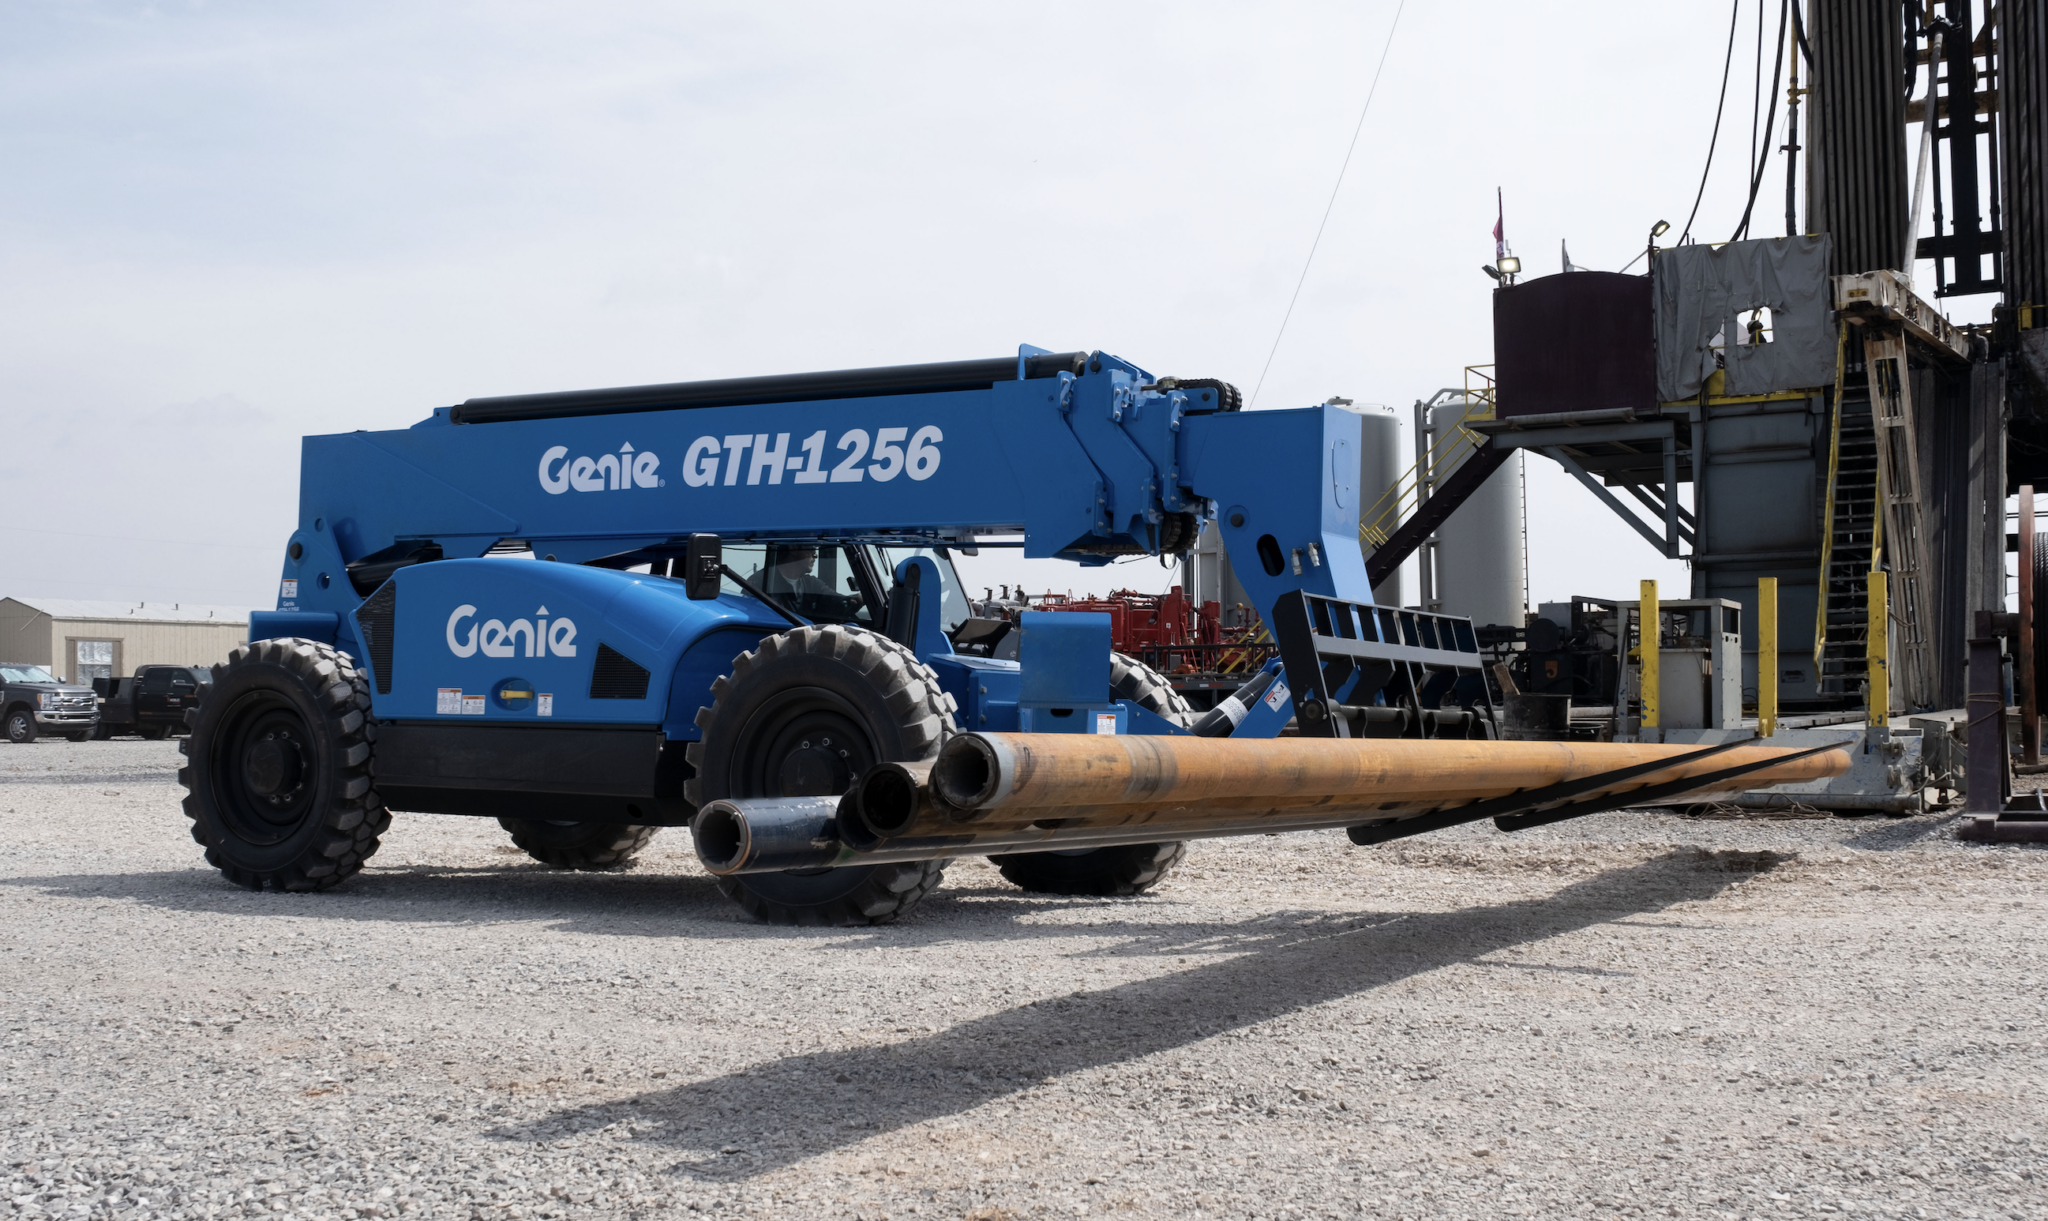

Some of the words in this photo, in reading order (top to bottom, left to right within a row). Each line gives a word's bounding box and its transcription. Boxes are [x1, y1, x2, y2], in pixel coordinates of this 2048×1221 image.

[538, 441, 660, 495] Genie
[682, 425, 943, 487] GTH-1256
[446, 604, 577, 658] Genie
